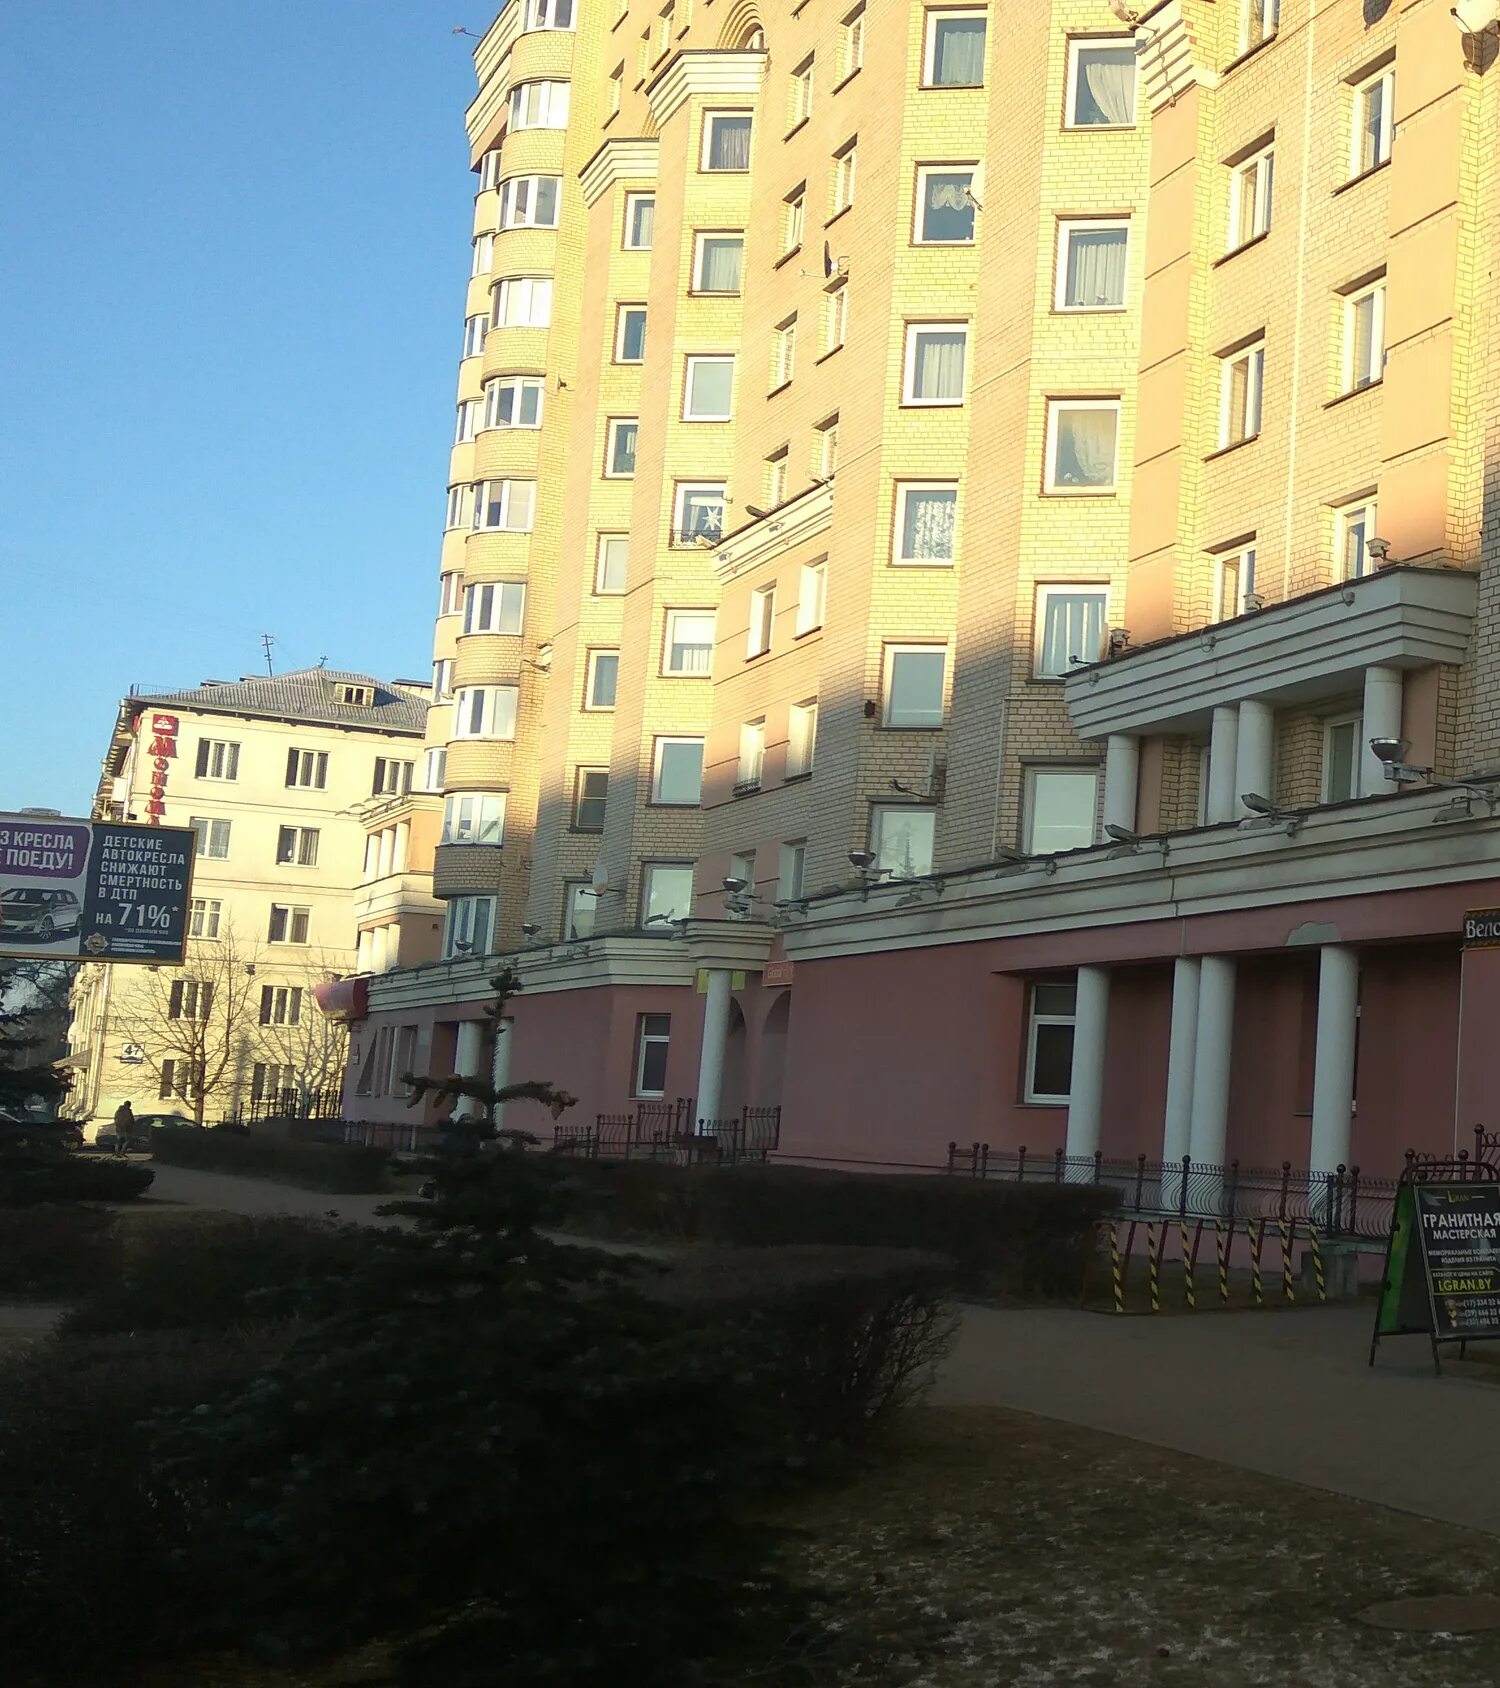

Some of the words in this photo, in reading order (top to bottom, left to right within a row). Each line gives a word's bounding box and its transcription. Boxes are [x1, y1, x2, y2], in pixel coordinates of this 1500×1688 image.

[13, 831, 74, 850] КРЕСЛА
[103, 835, 163, 850] ДЕТСКИЕ
[6, 848, 73, 870] ПОЕДУ!
[102, 849, 185, 865] АВТОКРЕСЛА
[101, 862, 167, 876] СНИЖАЮТ
[99, 875, 183, 891] СМЕРТНОСТЬ
[98, 887, 106, 898] В
[110, 888, 137, 901] ДТП
[95, 912, 113, 925] НА
[1433, 1228, 1497, 1240] МАСТЕРСКАЯ
[1438, 1278, 1492, 1292] LGRAN.BY
